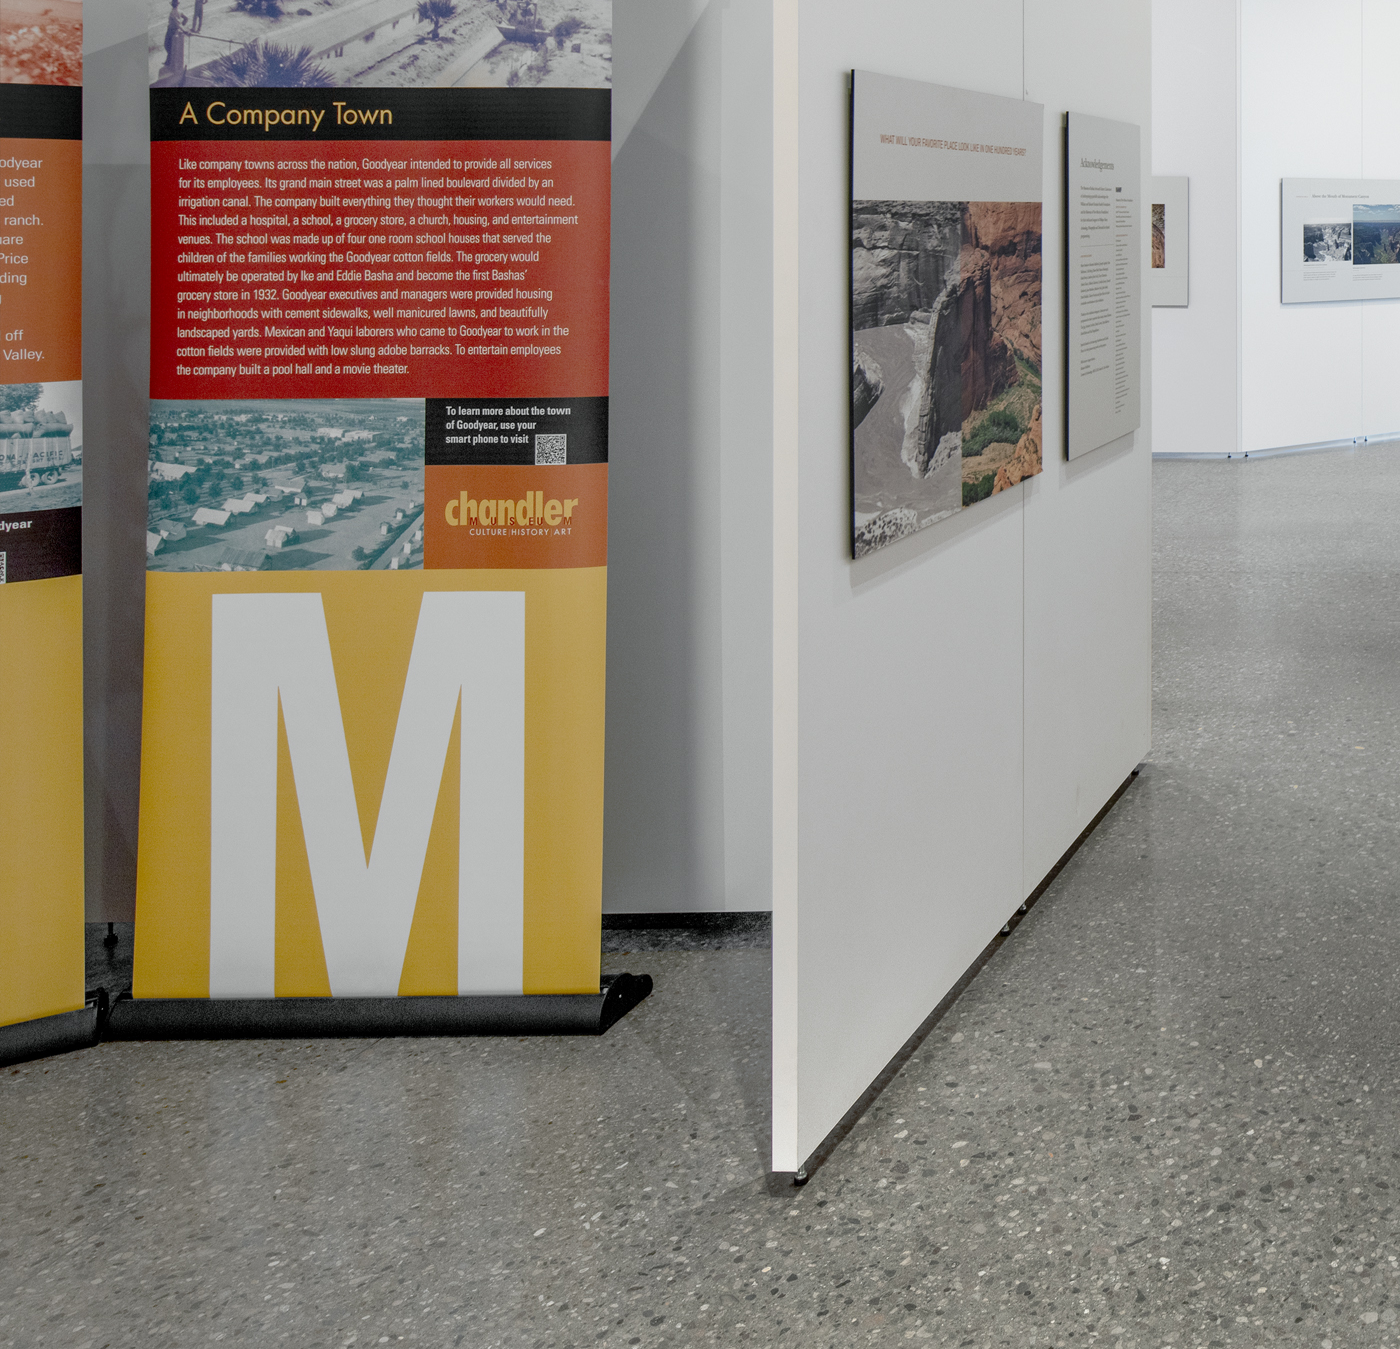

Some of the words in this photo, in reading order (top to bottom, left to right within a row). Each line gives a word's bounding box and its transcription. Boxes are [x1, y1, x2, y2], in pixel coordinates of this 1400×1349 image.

[179, 101, 199, 125] A
[206, 101, 325, 132] Company
[332, 101, 393, 125] Town
[880, 134, 895, 145] WHAT
[895, 136, 908, 146] WILL
[908, 137, 922, 147] YOUR
[922, 138, 943, 149] FAVORITE
[944, 140, 958, 151] PLACE
[958, 142, 970, 151] LOOK
[970, 143, 979, 152] LIKE
[979, 144, 985, 153] IN
[985, 145, 993, 153] ONE
[994, 145, 1012, 155] HUNDRED
[1013, 147, 1026, 156] YEARS?
[178, 158, 198, 170] Like
[198, 160, 243, 172] company
[244, 160, 275, 170] towns
[276, 160, 308, 170] across
[310, 158, 326, 170] the
[328, 158, 360, 170] nation,
[362, 158, 408, 172] Goodyear
[410, 158, 451, 170] intended
[452, 159, 463, 170] to
[464, 158, 498, 172] provide
[499, 158, 511, 169] all
[514, 158, 552, 170] services
[4, 176, 35, 188] used
[178, 176, 192, 189] for
[193, 176, 206, 189] its
[207, 177, 262, 191] employees.
[265, 177, 277, 188] Its
[279, 177, 307, 191] grand
[309, 176, 332, 188] main
[334, 178, 362, 188] street
[363, 179, 384, 188] was
[386, 179, 392, 188] a
[394, 177, 419, 190] palm
[421, 176, 444, 188] lined
[446, 176, 490, 188] boulevard
[492, 176, 526, 188] divided
[528, 176, 540, 190] by
[541, 179, 554, 188] an
[178, 195, 220, 210] irrigation
[222, 196, 252, 207] canal.
[254, 195, 273, 207] The
[274, 198, 318, 209] company
[319, 195, 341, 207] built
[342, 195, 391, 210] everything
[393, 195, 415, 209] they
[417, 195, 453, 209] thought
[455, 195, 476, 207] their
[477, 195, 514, 206] workers
[516, 195, 546, 206] would
[548, 195, 575, 206] need.
[4, 214, 44, 226] ranch.
[178, 214, 197, 226] This
[199, 214, 239, 226] included
[240, 216, 248, 226] a
[250, 214, 291, 228] hospital,
[292, 216, 299, 226] a
[301, 214, 334, 226] school,
[335, 216, 342, 226] a
[344, 216, 379, 228] grocery
[380, 215, 407, 226] store,
[409, 216, 416, 226] a
[417, 214, 451, 226] church,
[453, 213, 490, 228] housing,
[492, 214, 510, 225] and
[511, 214, 579, 225] entertainment
[177, 235, 213, 245] venues.
[215, 232, 234, 245] The
[236, 233, 268, 245] school
[270, 235, 291, 244] was
[293, 232, 320, 244] made
[321, 235, 334, 246] up
[335, 232, 346, 244] of
[347, 232, 367, 244] four
[368, 235, 387, 244] one
[388, 235, 414, 244] room
[416, 232, 446, 244] school
[448, 232, 480, 244] houses
[482, 232, 501, 244] that
[502, 232, 534, 244] served
[536, 232, 552, 244] the
[177, 251, 215, 264] children
[216, 251, 227, 263] of
[229, 251, 246, 263] the
[247, 251, 287, 263] families
[288, 251, 327, 266] working
[328, 251, 344, 263] the
[346, 250, 391, 265] Goodyear
[393, 252, 424, 262] cotton
[426, 250, 454, 262] fields.
[456, 250, 473, 262] The
[474, 253, 509, 265] grocery
[510, 250, 540, 262] would
[5, 330, 24, 341] off
[3, 349, 45, 361] Valley.
[446, 406, 456, 416] To
[458, 406, 480, 415] learn
[505, 406, 529, 415] about
[531, 406, 545, 415] the
[547, 407, 571, 415] town
[446, 420, 455, 429] of
[457, 420, 499, 431] Goodyear,
[517, 422, 537, 431] your
[446, 435, 471, 444] smart
[473, 434, 498, 445] phone
[510, 434, 529, 443] visit
[445, 490, 578, 526] chandler
[469, 528, 507, 536] CULTURE
[210, 591, 525, 999] M
